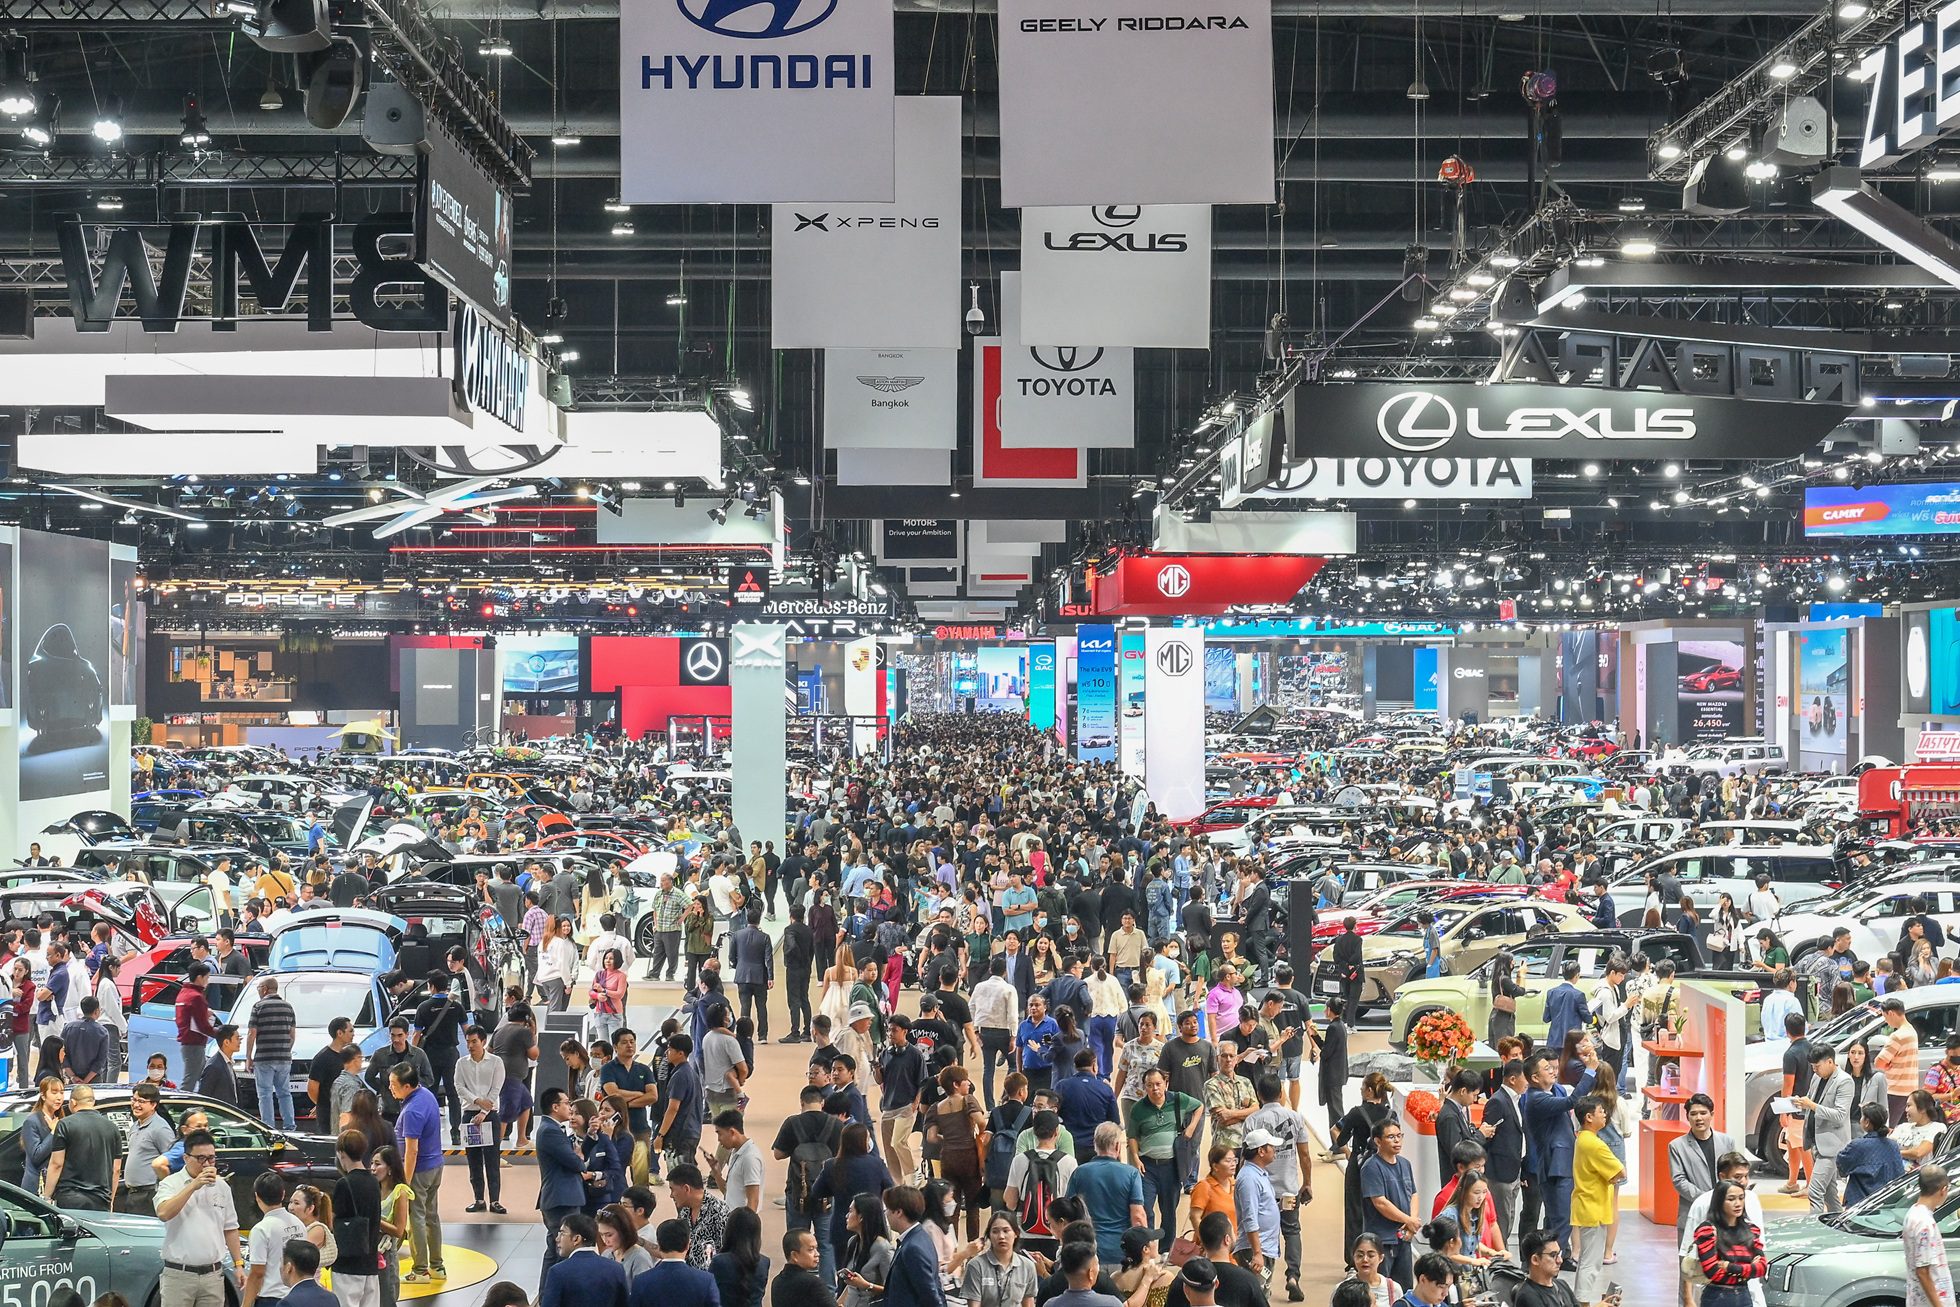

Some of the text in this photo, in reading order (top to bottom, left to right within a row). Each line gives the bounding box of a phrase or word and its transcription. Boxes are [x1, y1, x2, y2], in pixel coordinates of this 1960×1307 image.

[1019, 16, 1249, 32] GEELY RIDDARA
[641, 54, 872, 89] HYUNDAI
[836, 216, 939, 229] XPENG
[1043, 232, 1188, 252] LEXUS
[1017, 378, 1117, 396] TOYOTA
[871, 399, 909, 409] Bangkok
[1466, 407, 1696, 439] LEXUS
[1822, 508, 1864, 521] CAMRY
[903, 519, 938, 527] MOTORS
[906, 530, 921, 538] your
[1159, 565, 1188, 594] MG
[225, 593, 356, 606] PORSCHE
[948, 626, 996, 639] YAMAHA
[1160, 644, 1190, 673] MG
[1693, 720, 1722, 728] 26,450
[0, 1261, 73, 1280] RTING FROM
